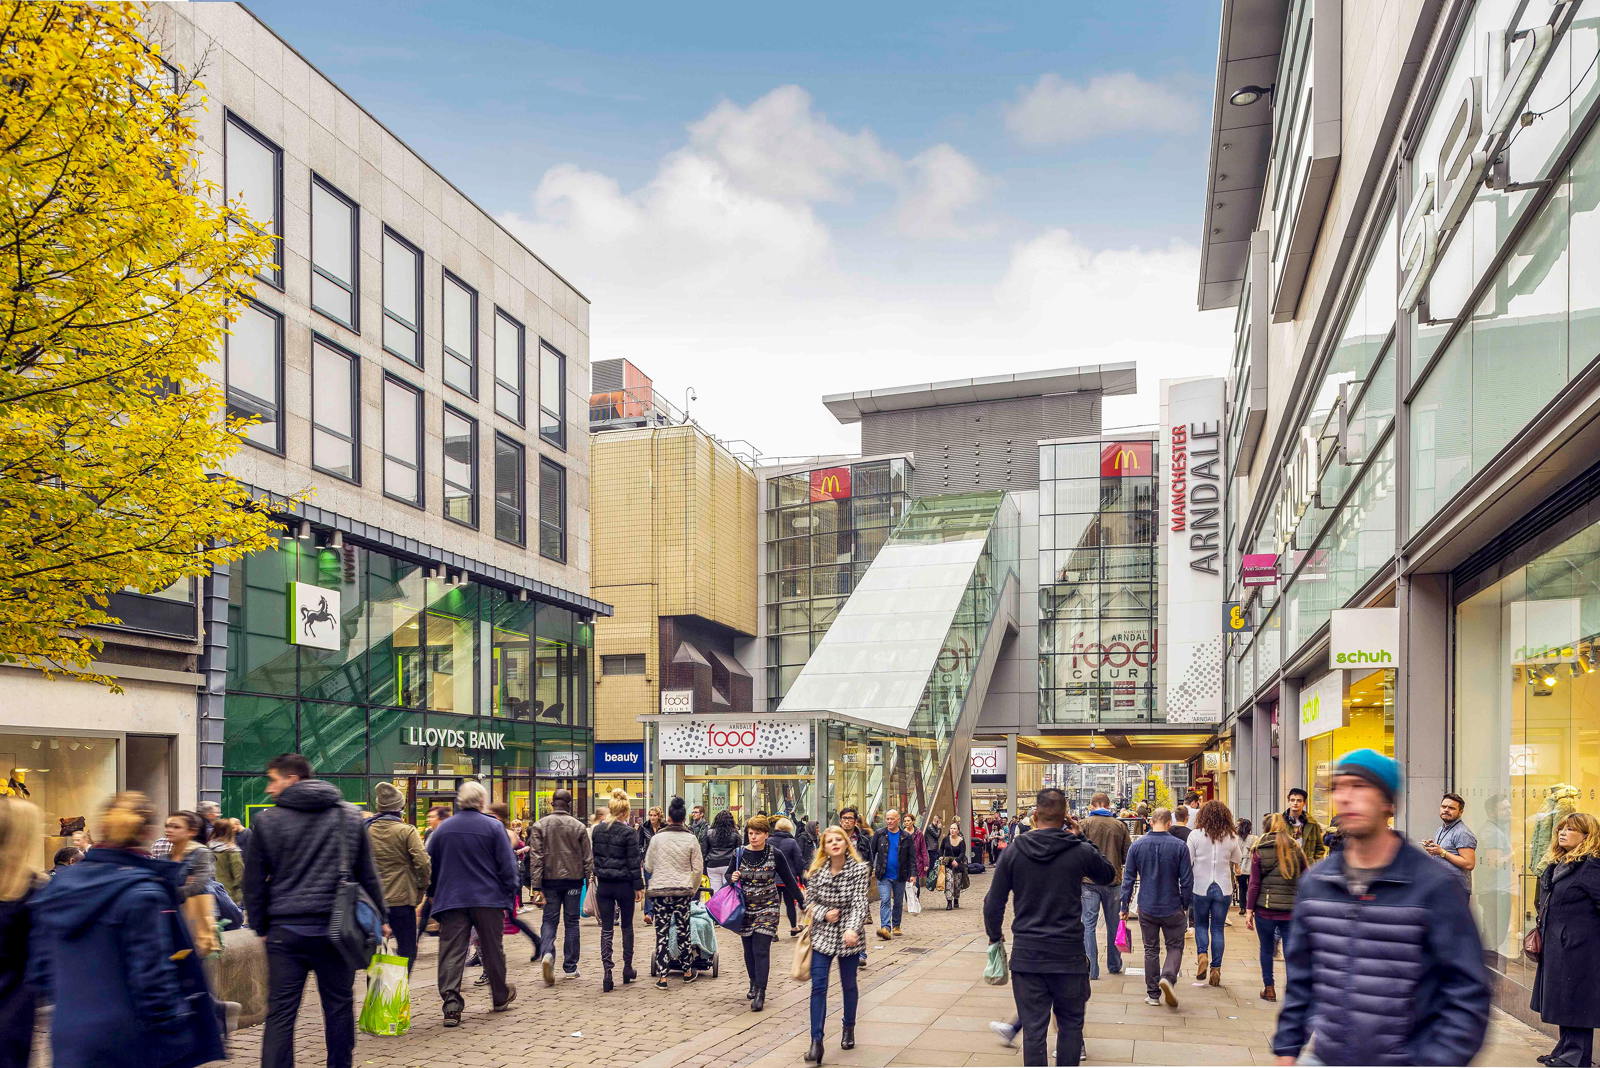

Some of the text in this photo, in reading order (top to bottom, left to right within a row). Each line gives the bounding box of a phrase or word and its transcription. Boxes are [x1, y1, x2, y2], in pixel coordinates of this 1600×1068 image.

[1171, 424, 1187, 532] MANCHESTER
[1190, 420, 1220, 576] ARNDALE
[1072, 628, 1158, 669] food
[1111, 632, 1150, 641] ARNDAL
[1336, 649, 1392, 663] schuh
[664, 693, 689, 706] food
[409, 726, 505, 750] LLOYDS BANK
[706, 722, 756, 747] food
[604, 752, 639, 764] beauty
